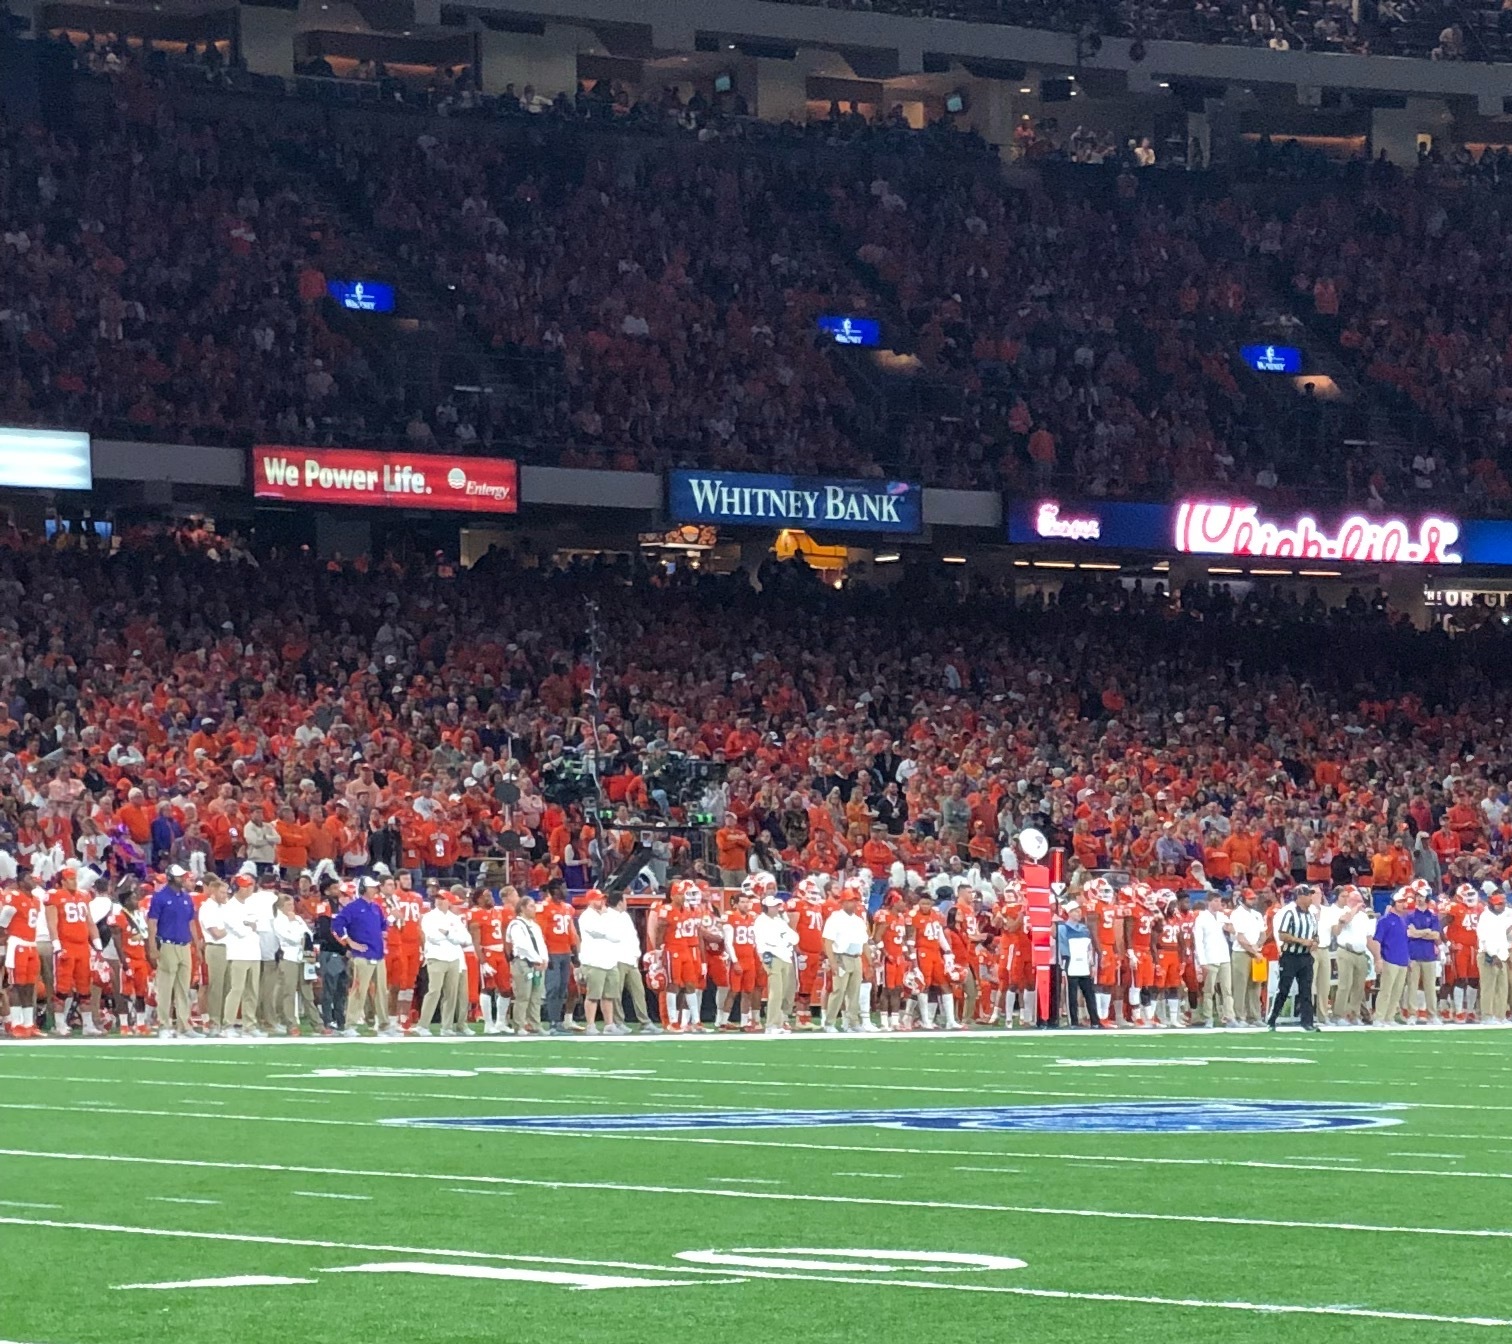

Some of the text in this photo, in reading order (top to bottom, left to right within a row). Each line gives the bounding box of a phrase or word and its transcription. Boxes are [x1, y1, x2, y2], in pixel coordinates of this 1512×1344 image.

[263, 456, 432, 495] We Power Life.
[465, 480, 510, 500] Entergy
[688, 478, 901, 523] WHITNEY BANK
